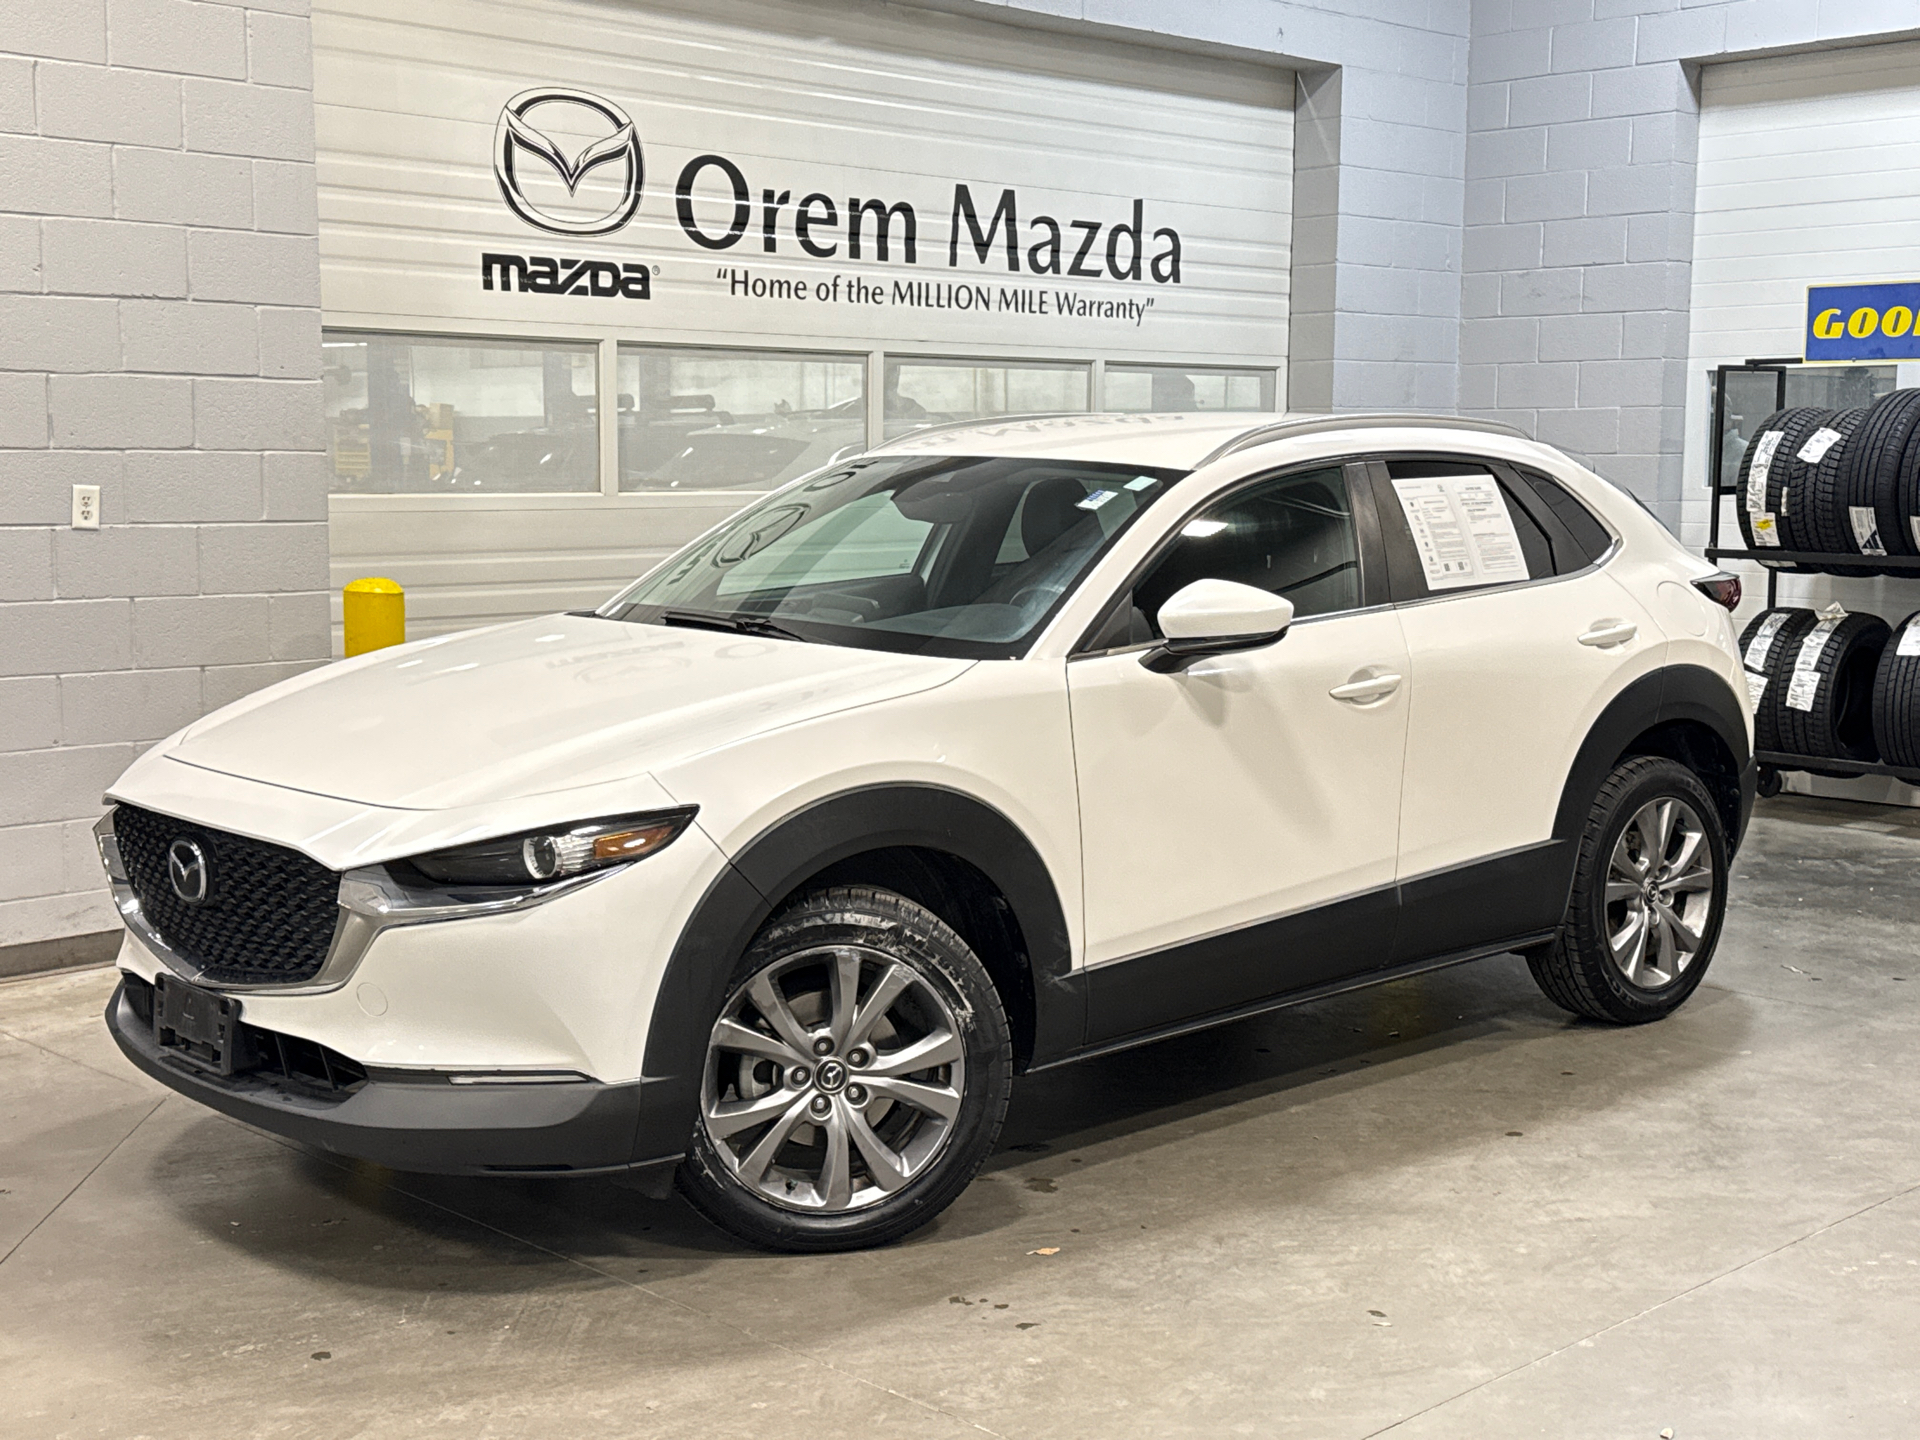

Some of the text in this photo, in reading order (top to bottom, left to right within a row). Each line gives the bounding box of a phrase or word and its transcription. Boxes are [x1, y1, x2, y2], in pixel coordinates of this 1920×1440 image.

[675, 154, 1182, 284] Orem Mazda
[717, 268, 1154, 327] “Home of the MILLION MILE Warranty”
[1812, 305, 1920, 339] GOO
